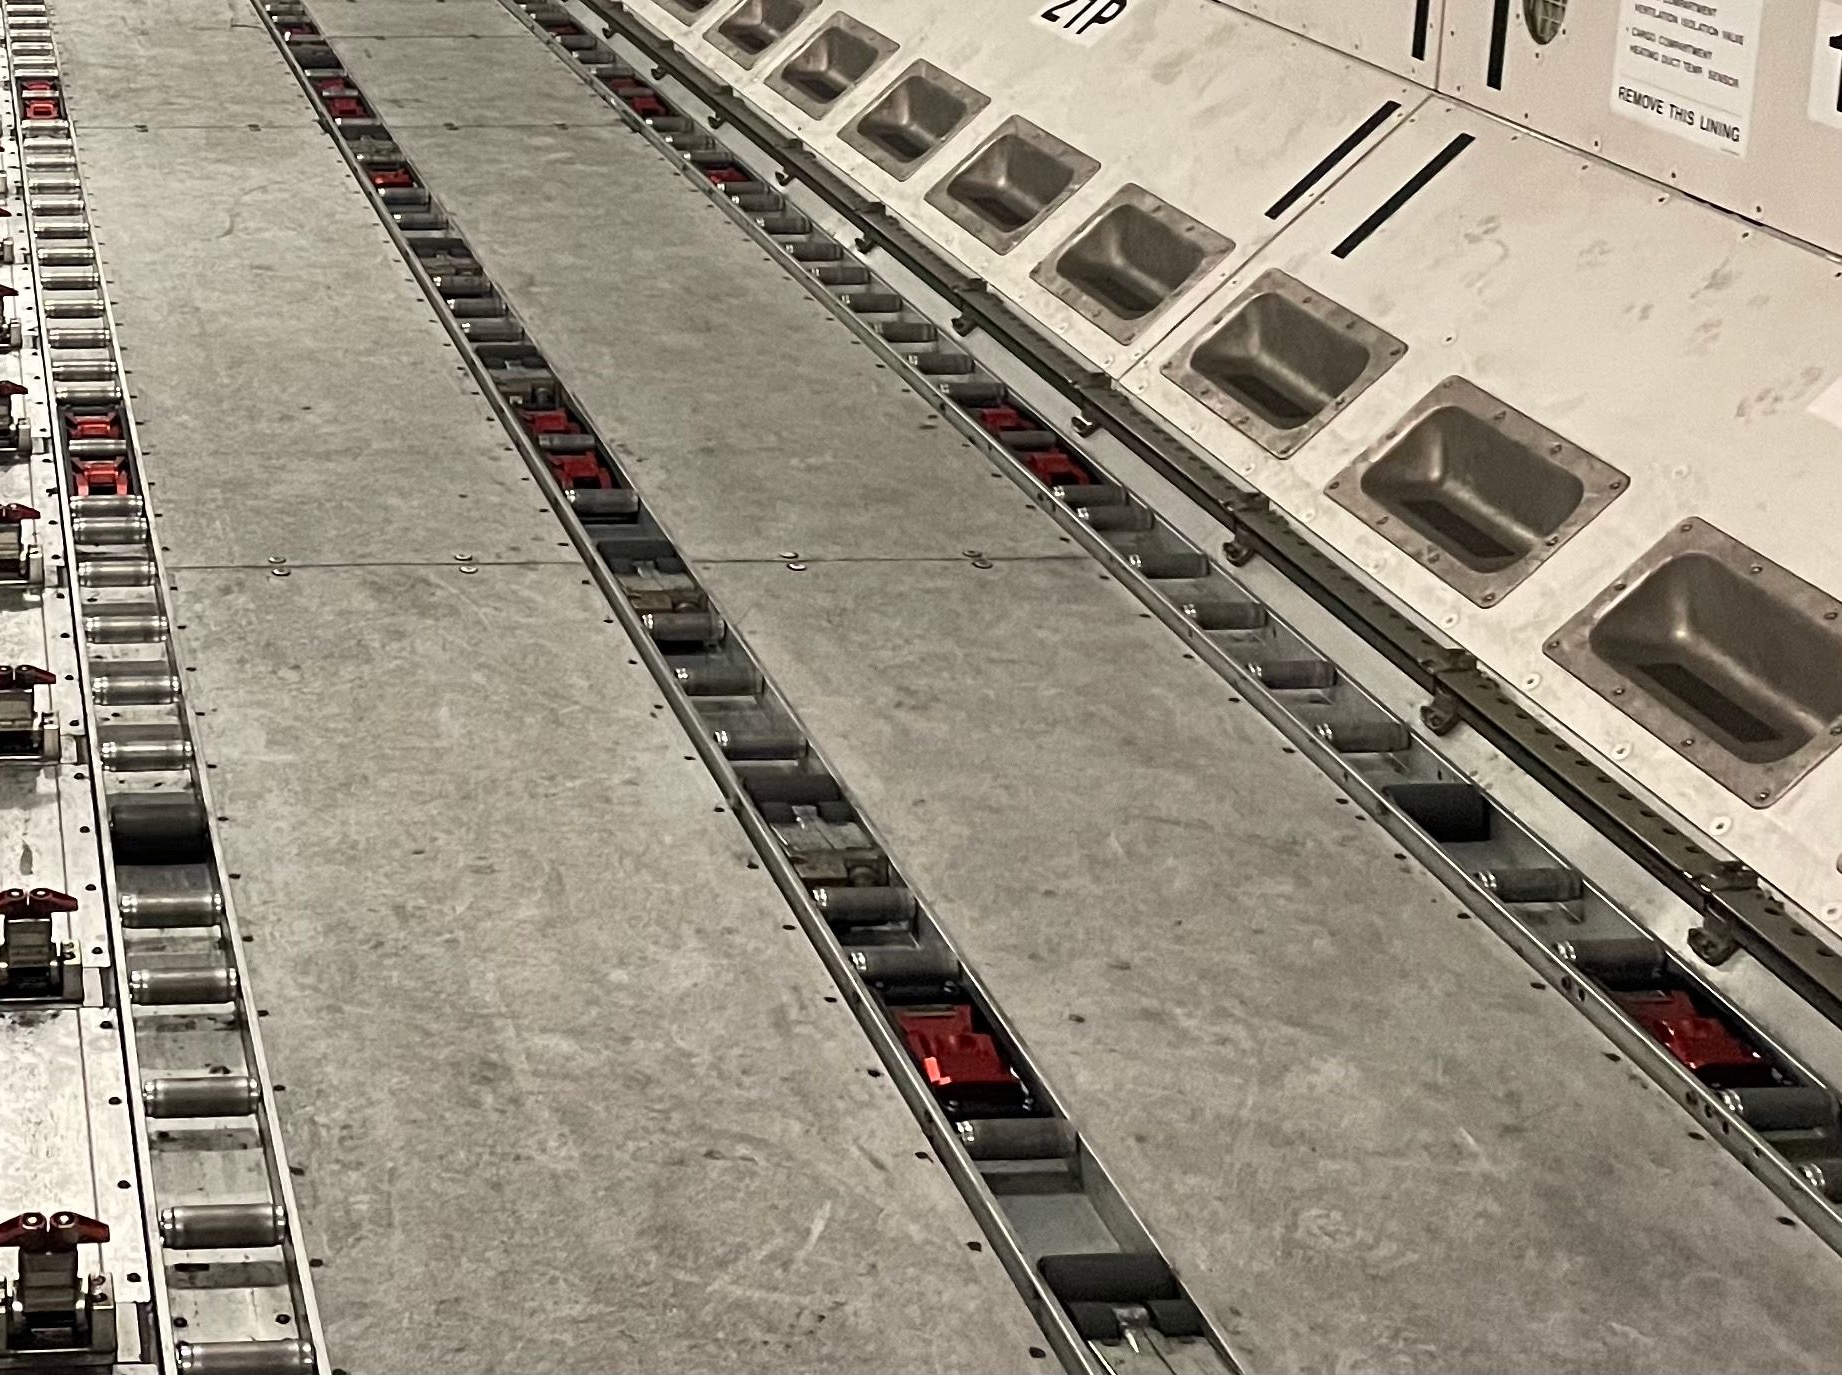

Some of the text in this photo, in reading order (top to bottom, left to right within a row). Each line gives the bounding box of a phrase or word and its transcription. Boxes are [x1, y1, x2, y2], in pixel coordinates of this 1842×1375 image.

[1618, 86, 1740, 142] REMOVE THIS LINING
